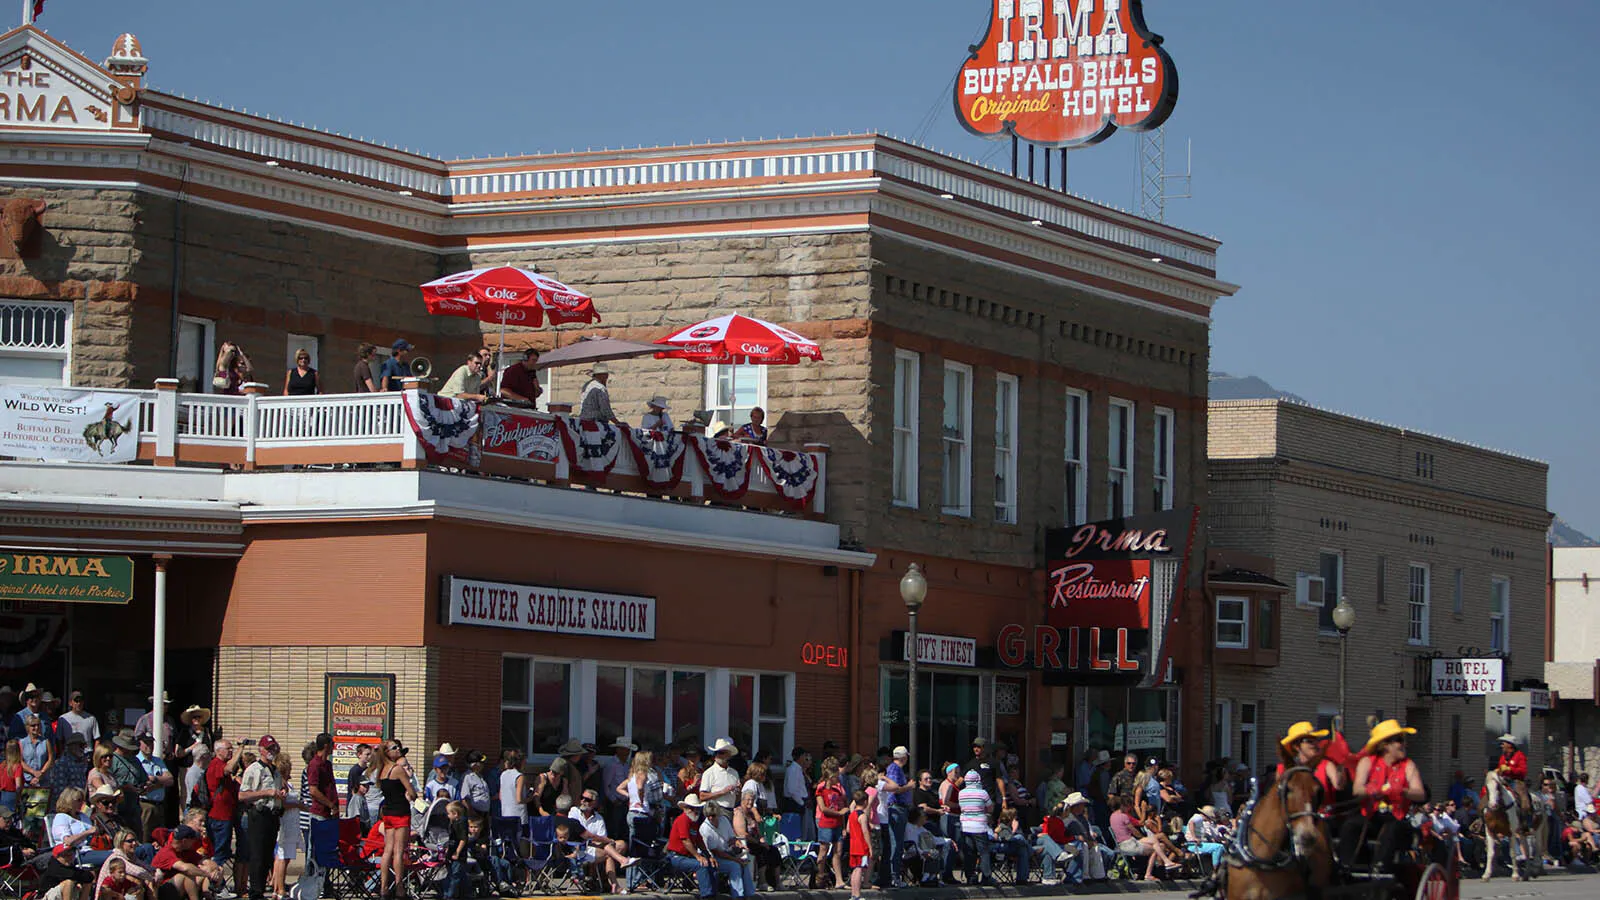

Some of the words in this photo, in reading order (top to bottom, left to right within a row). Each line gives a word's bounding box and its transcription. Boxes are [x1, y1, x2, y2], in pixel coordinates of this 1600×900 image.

[997, 0, 1128, 62] IRMA
[2, 71, 50, 88] THE
[964, 62, 1073, 95] BUFFALO
[1082, 57, 1156, 88] BILLS
[970, 92, 1050, 122] Original
[1062, 87, 1150, 117] HOTEL
[485, 286, 517, 300] Coke
[740, 343, 769, 355] Coke
[4, 399, 39, 412] WILD
[43, 402, 87, 415] WEST!
[486, 422, 554, 447] Budweiser
[1064, 524, 1172, 558] Irma
[12, 554, 111, 577] IRMA
[0, 584, 27, 596] iginal
[28, 583, 59, 595] Hotel
[59, 586, 67, 596] in
[69, 585, 86, 596] the
[87, 585, 126, 598] Rockies
[1050, 563, 1150, 609] Restaurant
[461, 585, 519, 623] SILVER
[527, 592, 586, 629] SADDLE
[591, 599, 648, 633] SALOON
[802, 642, 848, 668] OPEN
[907, 636, 937, 661] CDY'S
[940, 640, 973, 664] FINEST
[997, 624, 1139, 670] GRILL
[1445, 662, 1489, 675] HOTEL
[337, 686, 382, 700] SPONSORS
[1436, 679, 1497, 692] VACANCY
[333, 701, 387, 716] GUNFIGHTERS
